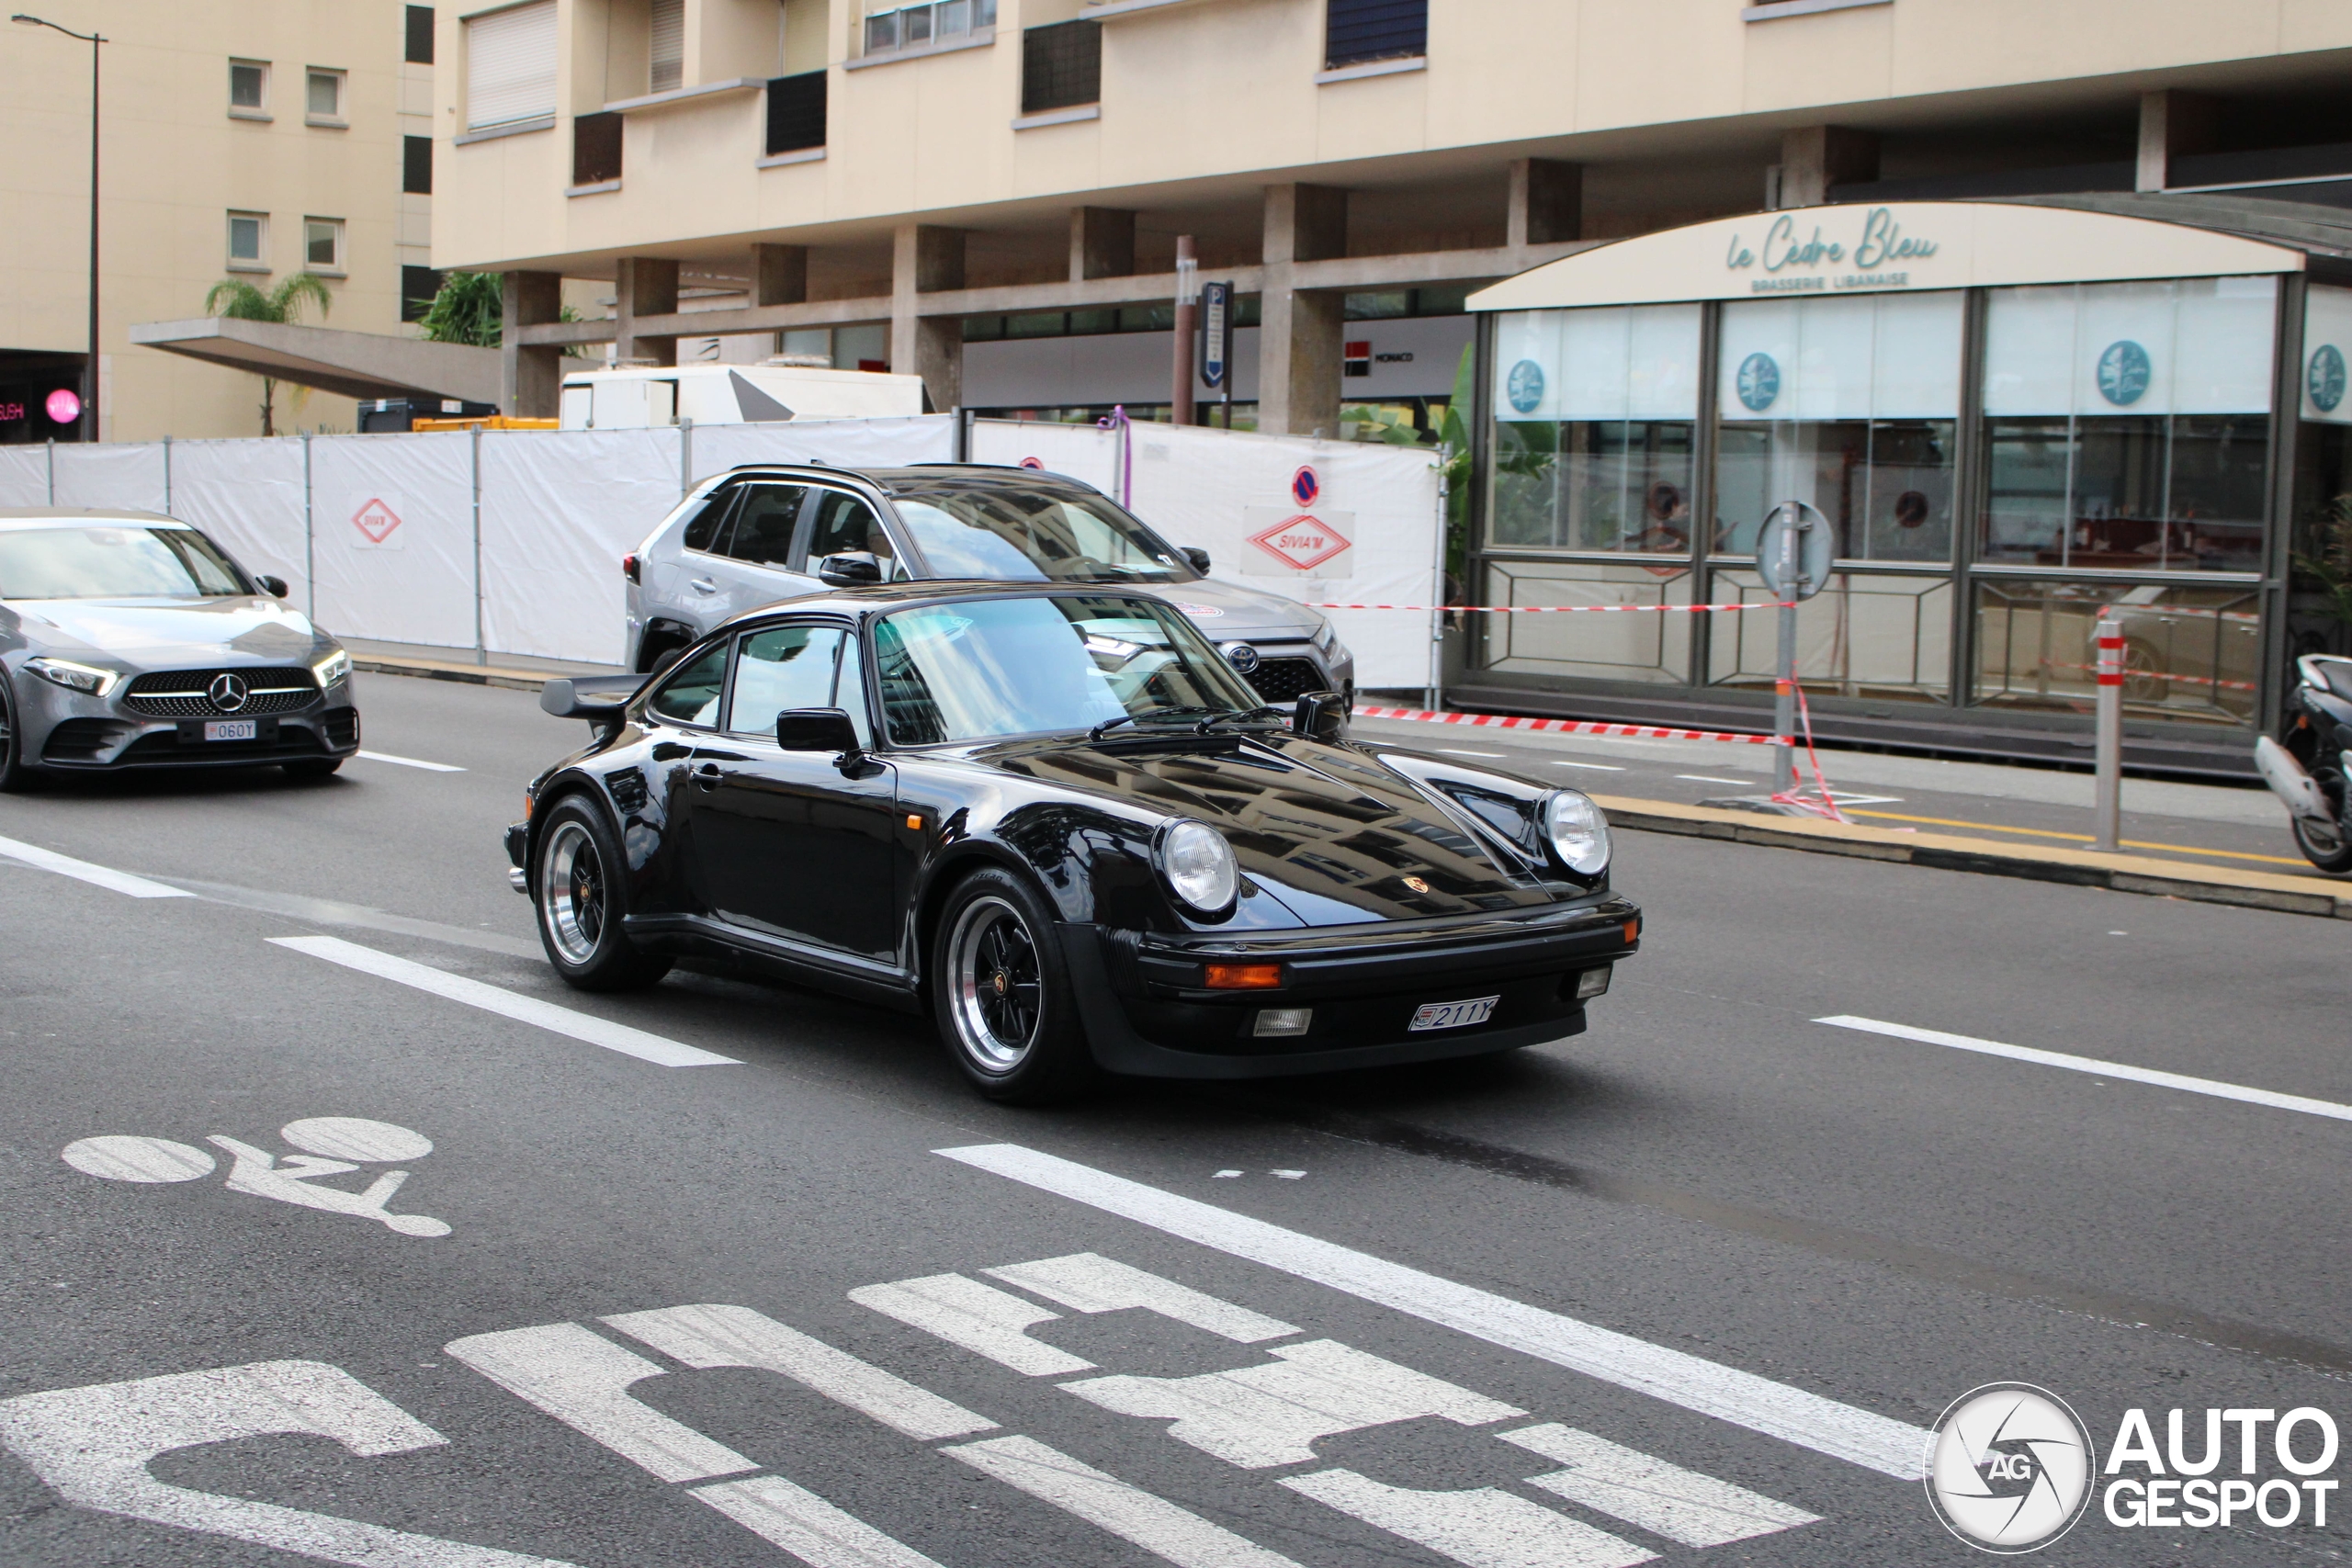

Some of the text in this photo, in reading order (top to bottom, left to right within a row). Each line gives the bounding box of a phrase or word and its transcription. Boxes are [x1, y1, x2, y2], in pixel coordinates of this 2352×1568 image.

[1763, 214, 1846, 272] Cèdre
[1855, 208, 1939, 269] Bleu
[1751, 272, 1909, 293] BRASSERIE LIBANAISE
[1211, 288, 1222, 304] P
[1375, 353, 1414, 363] MONACO
[219, 724, 254, 738] 060Y
[1432, 999, 1495, 1027] 211Y
